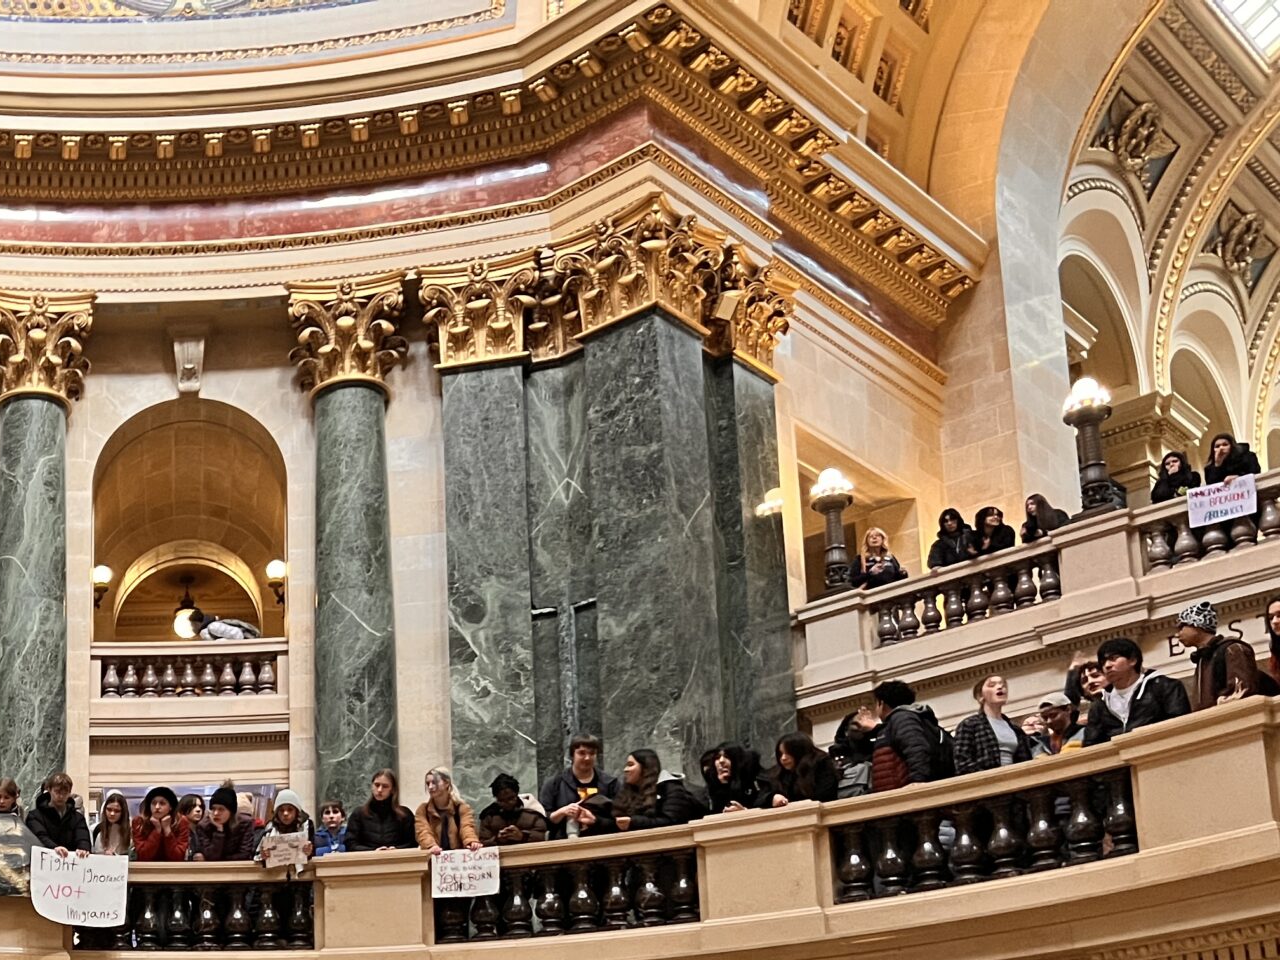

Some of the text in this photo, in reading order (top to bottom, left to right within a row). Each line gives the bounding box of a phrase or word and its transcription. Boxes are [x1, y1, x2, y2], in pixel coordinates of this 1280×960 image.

[40, 851, 78, 871] Fight
[436, 853, 456, 864] FIRE
[438, 872, 493, 885] YOU BURN
